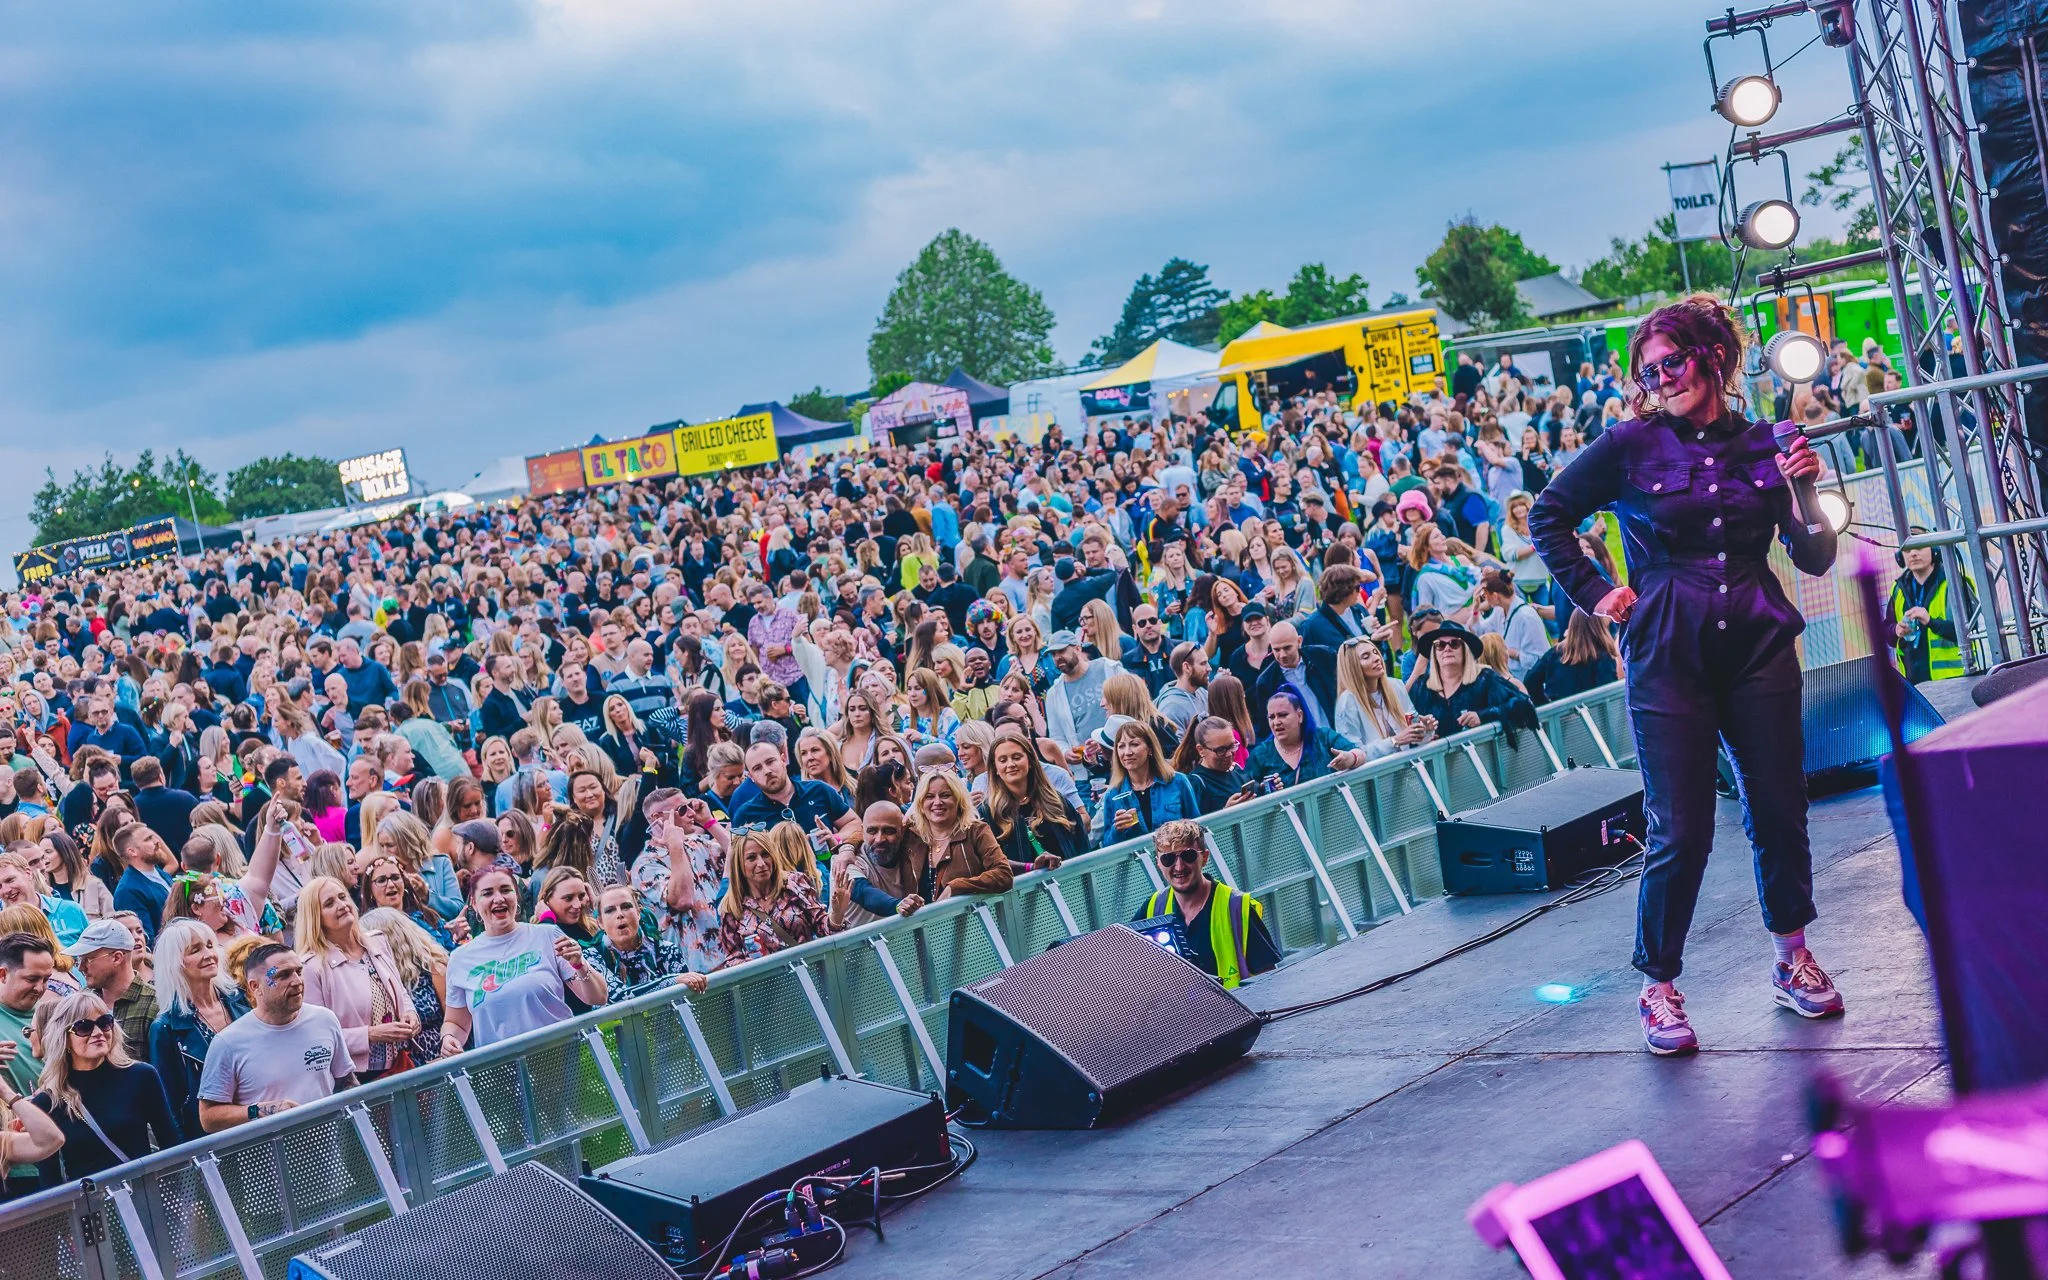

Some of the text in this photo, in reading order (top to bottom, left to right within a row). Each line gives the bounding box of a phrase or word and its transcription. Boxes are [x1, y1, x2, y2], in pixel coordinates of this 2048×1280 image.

[1373, 347, 1400, 369] 95%
[681, 418, 767, 452] GRILLED CHEESE
[591, 452, 614, 478] EL
[615, 441, 667, 474] TACO
[361, 470, 409, 502] ROLLS
[78, 542, 111, 560] PIZZA
[23, 562, 53, 582] FRIES
[1070, 686, 1103, 708] OSS
[467, 951, 542, 1009] 7UP
